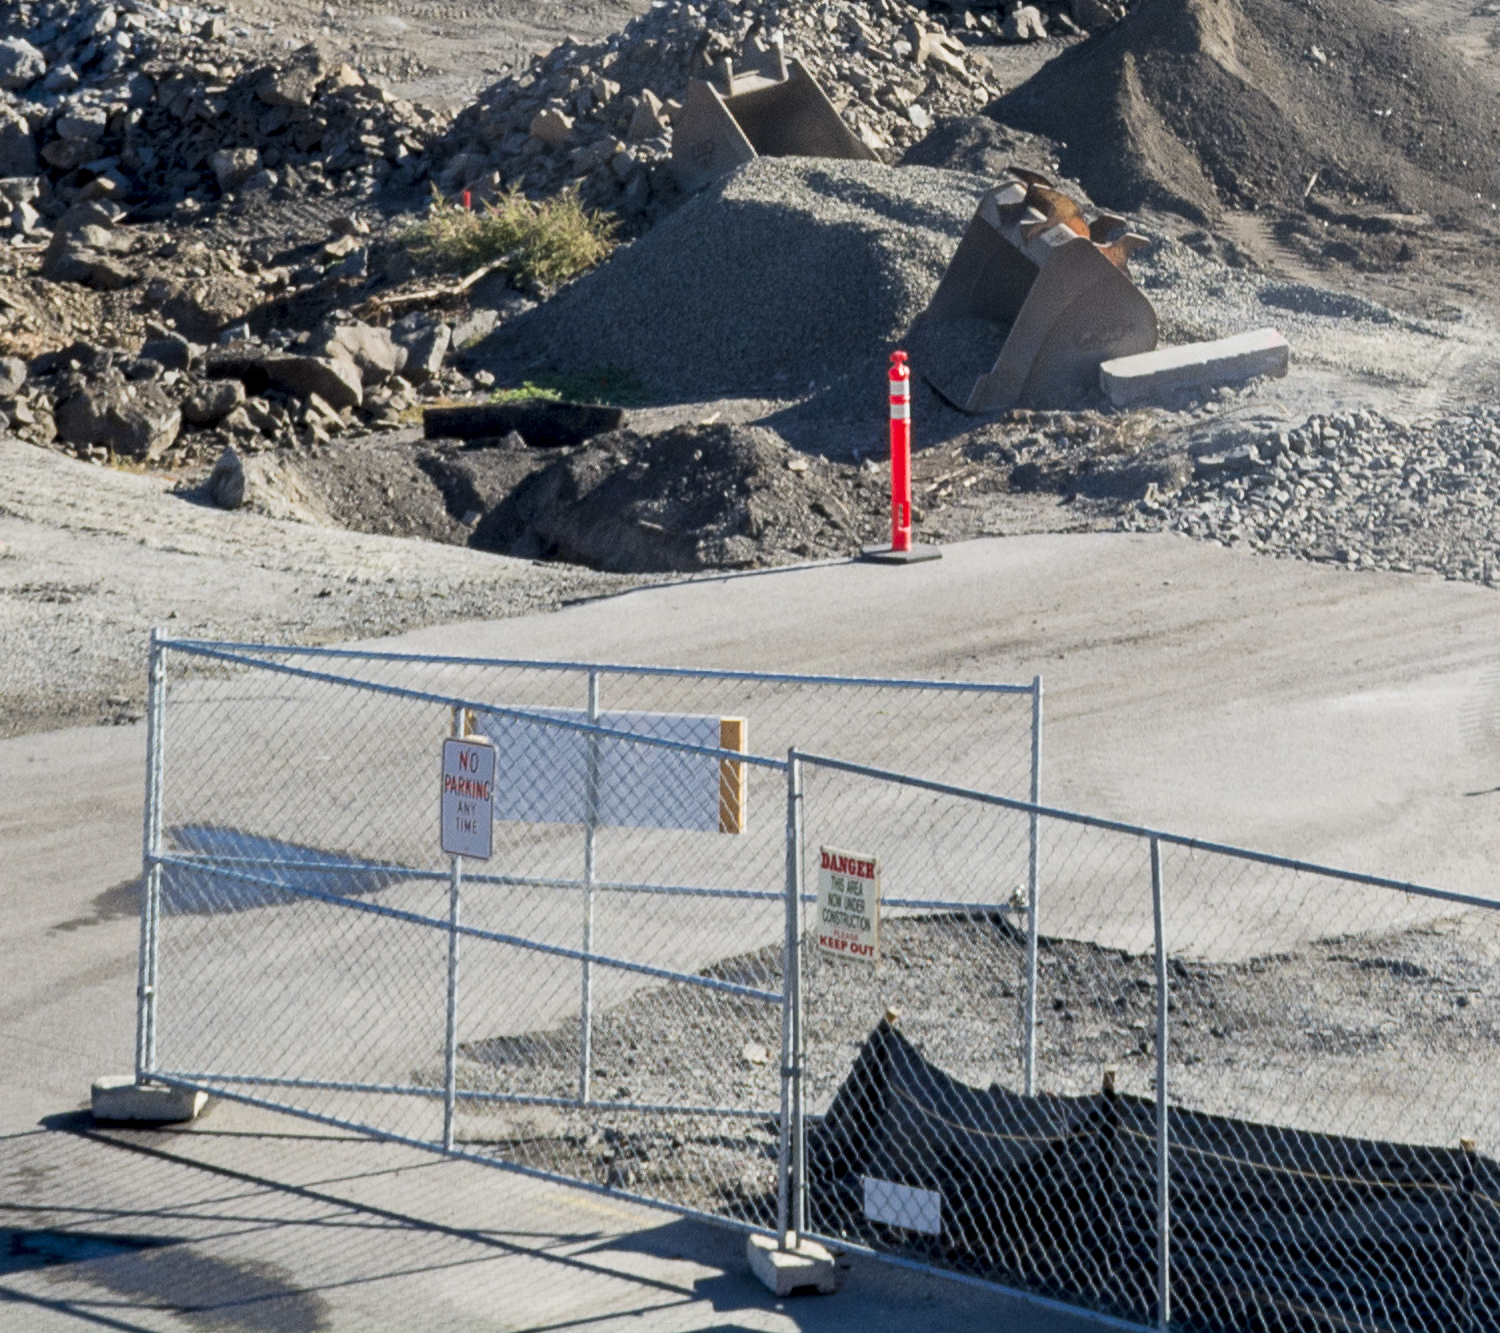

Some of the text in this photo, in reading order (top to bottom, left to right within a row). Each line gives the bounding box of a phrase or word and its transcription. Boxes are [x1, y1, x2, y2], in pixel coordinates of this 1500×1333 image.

[458, 750, 479, 773] NO
[445, 774, 490, 802] PARKING
[457, 801, 477, 815] ANY
[456, 817, 477, 834] TIME
[821, 852, 875, 880] DANGER
[847, 879, 863, 896] AREA
[844, 896, 866, 913] UNDER
[821, 907, 871, 932] CONSTRUCTION
[820, 934, 875, 957] KEEP OUT
